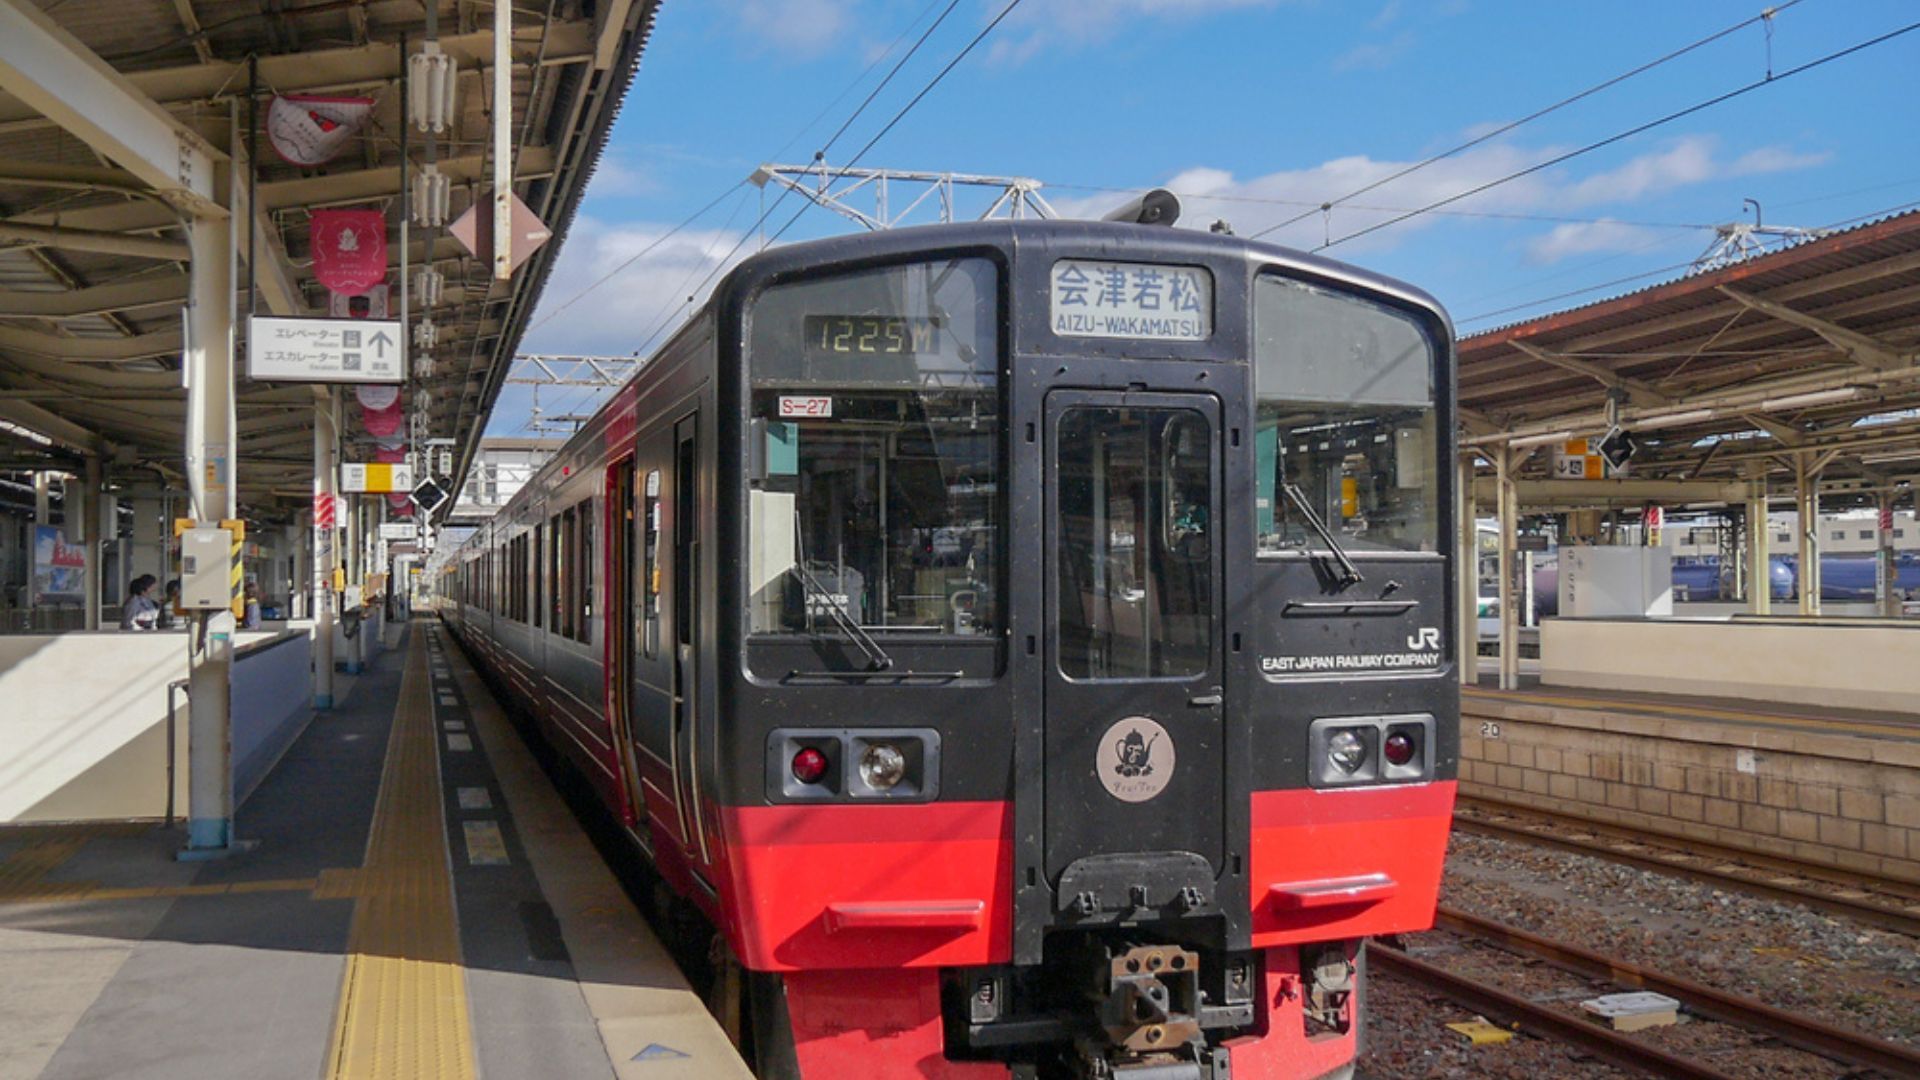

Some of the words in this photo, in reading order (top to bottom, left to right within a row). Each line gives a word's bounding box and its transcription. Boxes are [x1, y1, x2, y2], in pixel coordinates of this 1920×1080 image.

[1056, 264, 1201, 313] 会津若松
[1056, 314, 1203, 337] AIZU-WAKAMATSU
[275, 328, 340, 340] エレベーター
[264, 351, 340, 362] エスカレーター
[782, 399, 829, 415] S-27
[1406, 627, 1440, 650] JR
[1262, 656, 1296, 670] EAST
[1295, 656, 1335, 669] JAPAN
[1336, 654, 1383, 668] RAILWAY
[1384, 653, 1440, 666] COMPANY
[1482, 721, 1500, 737] 20
